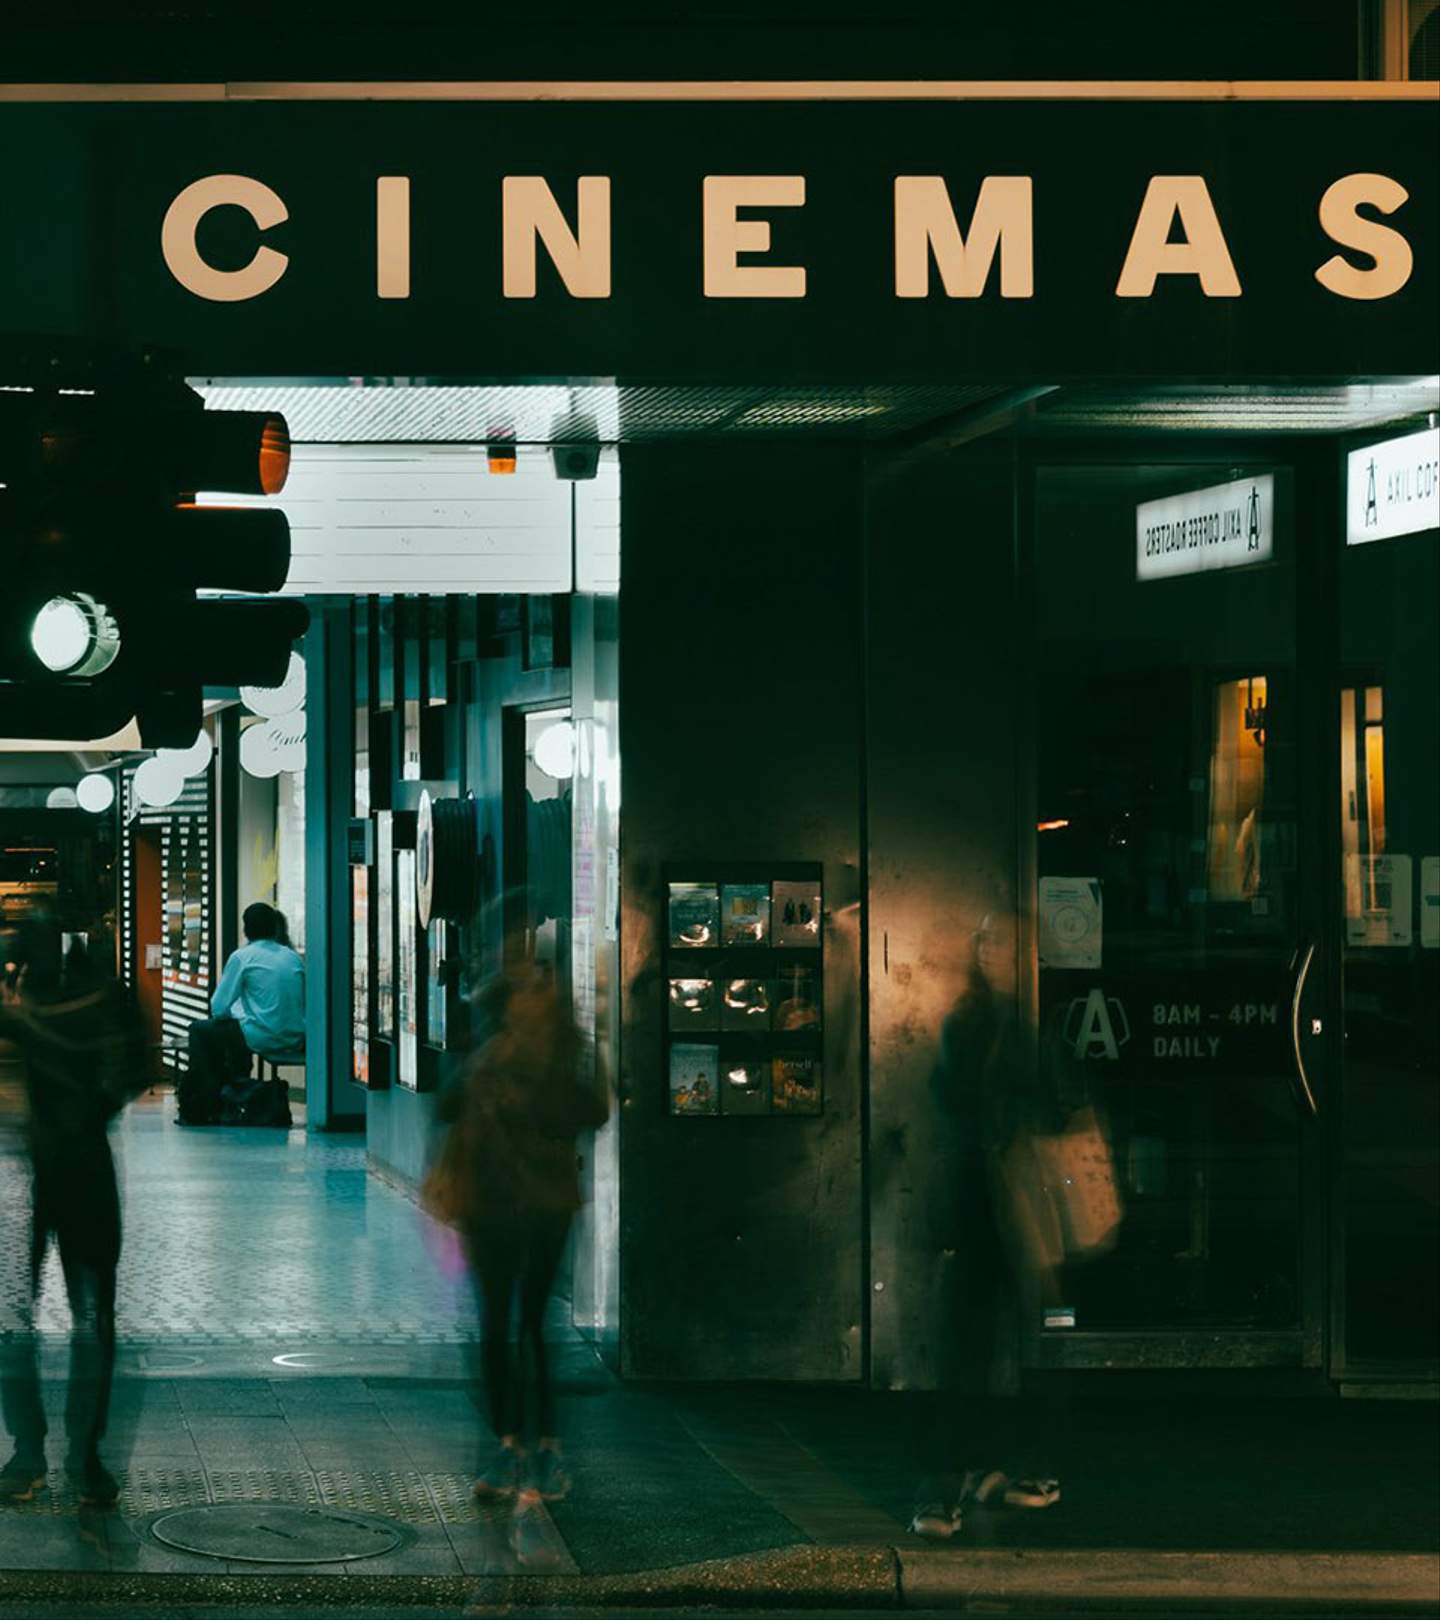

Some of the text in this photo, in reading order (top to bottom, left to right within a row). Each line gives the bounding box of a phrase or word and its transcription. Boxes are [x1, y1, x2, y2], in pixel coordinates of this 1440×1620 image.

[161, 173, 1413, 302] CINEMAS
[1387, 468, 1412, 504] AXIL
[1151, 1003, 1201, 1026] 8AM
[1228, 1003, 1278, 1026] 4PM
[1152, 1036, 1222, 1058] DAILY
